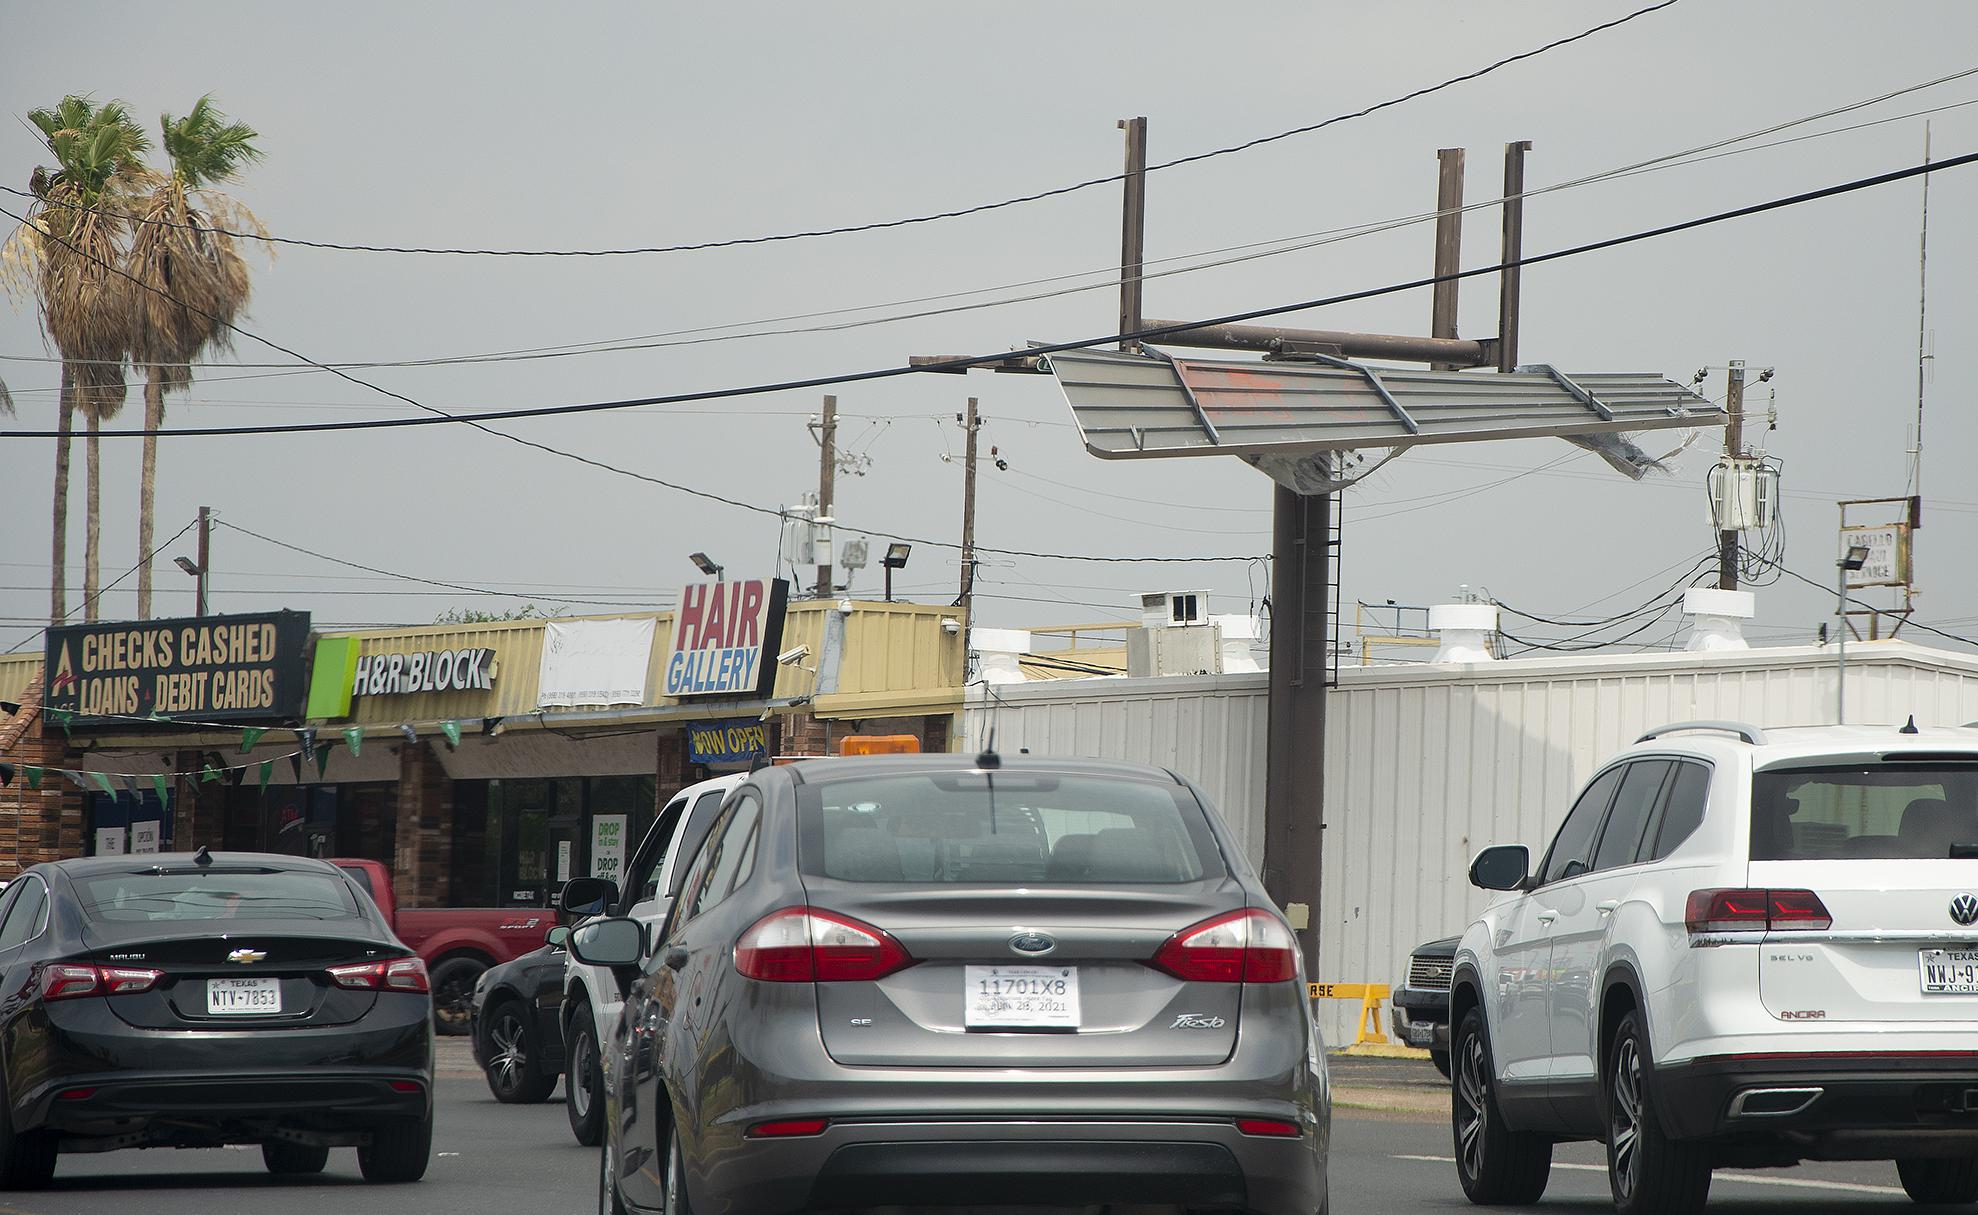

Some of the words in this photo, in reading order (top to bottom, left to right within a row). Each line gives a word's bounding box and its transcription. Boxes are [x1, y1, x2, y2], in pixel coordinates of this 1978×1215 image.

[676, 580, 765, 650] HAIR
[82, 629, 174, 672] CHECKS
[180, 623, 277, 666] CASHED
[353, 655, 402, 696] H&R
[407, 648, 490, 692] BLOCK
[667, 647, 758, 694] GALLERY
[80, 675, 140, 716] LOANS
[155, 672, 208, 712] DEBIT
[212, 668, 275, 709] CARDS
[691, 729, 726, 755] NOW
[727, 725, 766, 753] OPEN
[599, 822, 620, 836] DROP
[598, 857, 618, 871] DROP
[980, 979, 1066, 995] 11701X8
[1038, 1001, 1067, 1011] 2021
[850, 1018, 872, 1026] SE
[1169, 1013, 1226, 1029] Fiesta
